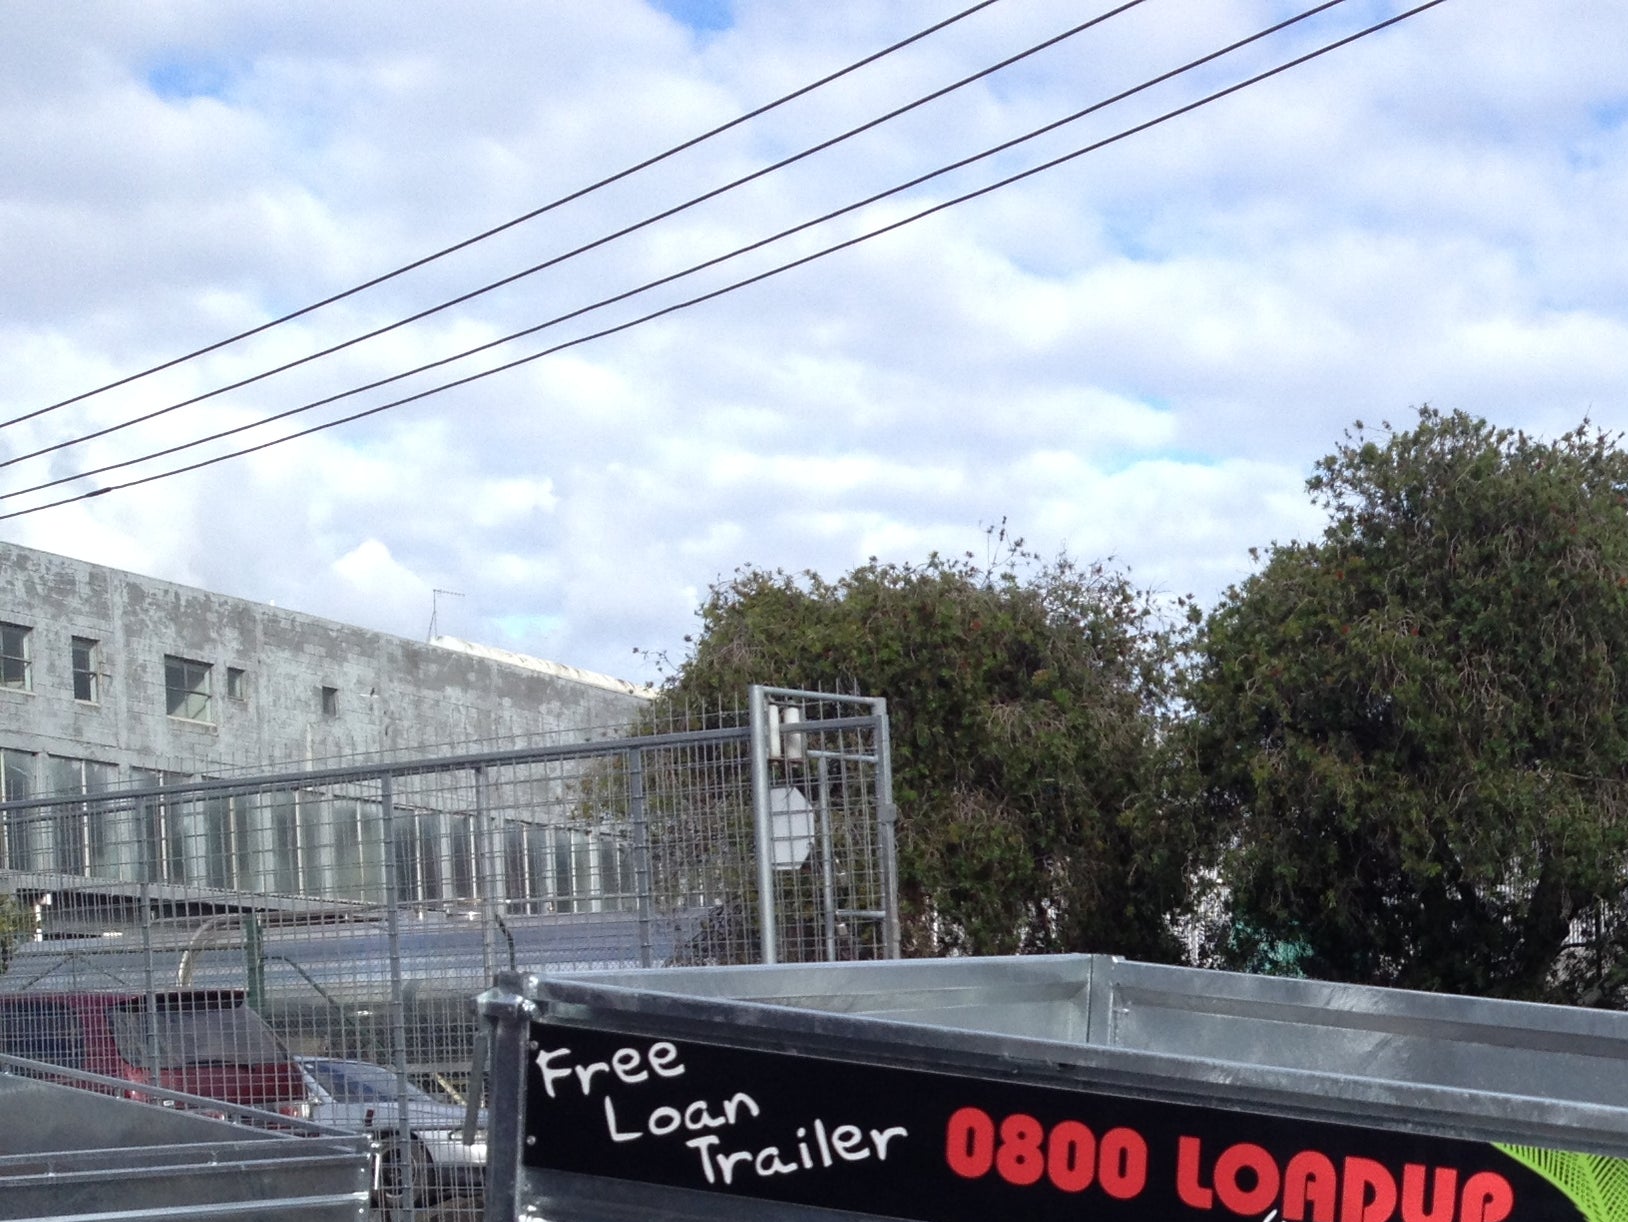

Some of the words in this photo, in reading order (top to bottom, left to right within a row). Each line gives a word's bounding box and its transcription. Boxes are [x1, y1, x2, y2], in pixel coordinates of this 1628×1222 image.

[536, 1041, 685, 1097] Free
[604, 1092, 760, 1142] Loan
[686, 1119, 909, 1184] Trailer
[946, 1107, 1147, 1198] 0800
